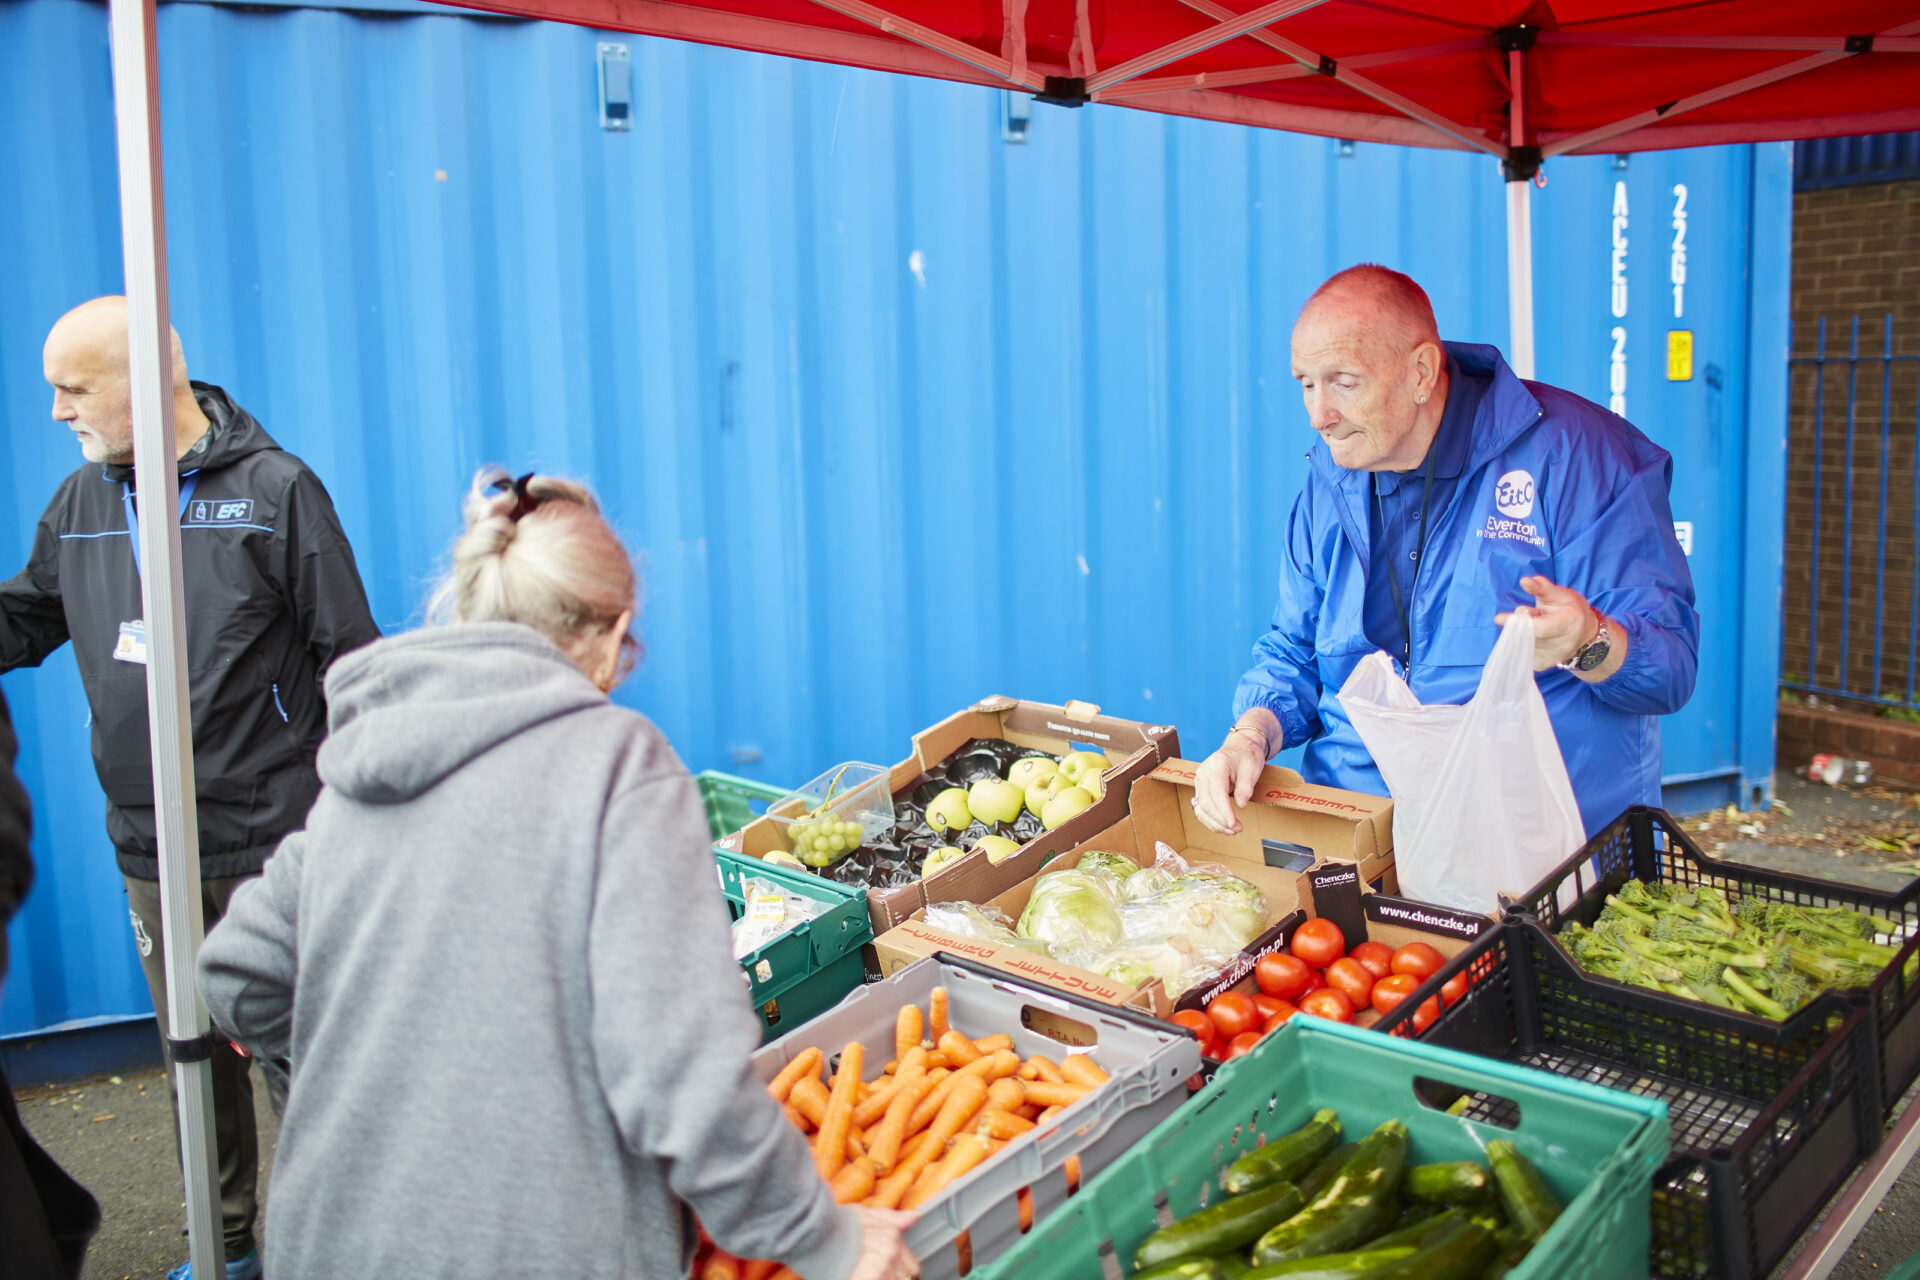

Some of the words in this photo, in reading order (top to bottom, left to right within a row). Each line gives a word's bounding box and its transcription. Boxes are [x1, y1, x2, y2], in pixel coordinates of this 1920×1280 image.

[1612, 181, 1628, 318] ACEU
[216, 502, 247, 519] EFC
[1486, 515, 1537, 536] Everton
[1476, 528, 1483, 537] in
[1484, 529, 1497, 539] the
[1498, 530, 1545, 547] Community
[1265, 789, 1373, 815] ICEBERG
[1314, 872, 1355, 885] Chenczke
[1379, 905, 1479, 934] www.chenczke.pl
[900, 926, 996, 958] ICEBERG
[1004, 960, 1118, 1000] LETTUCE
